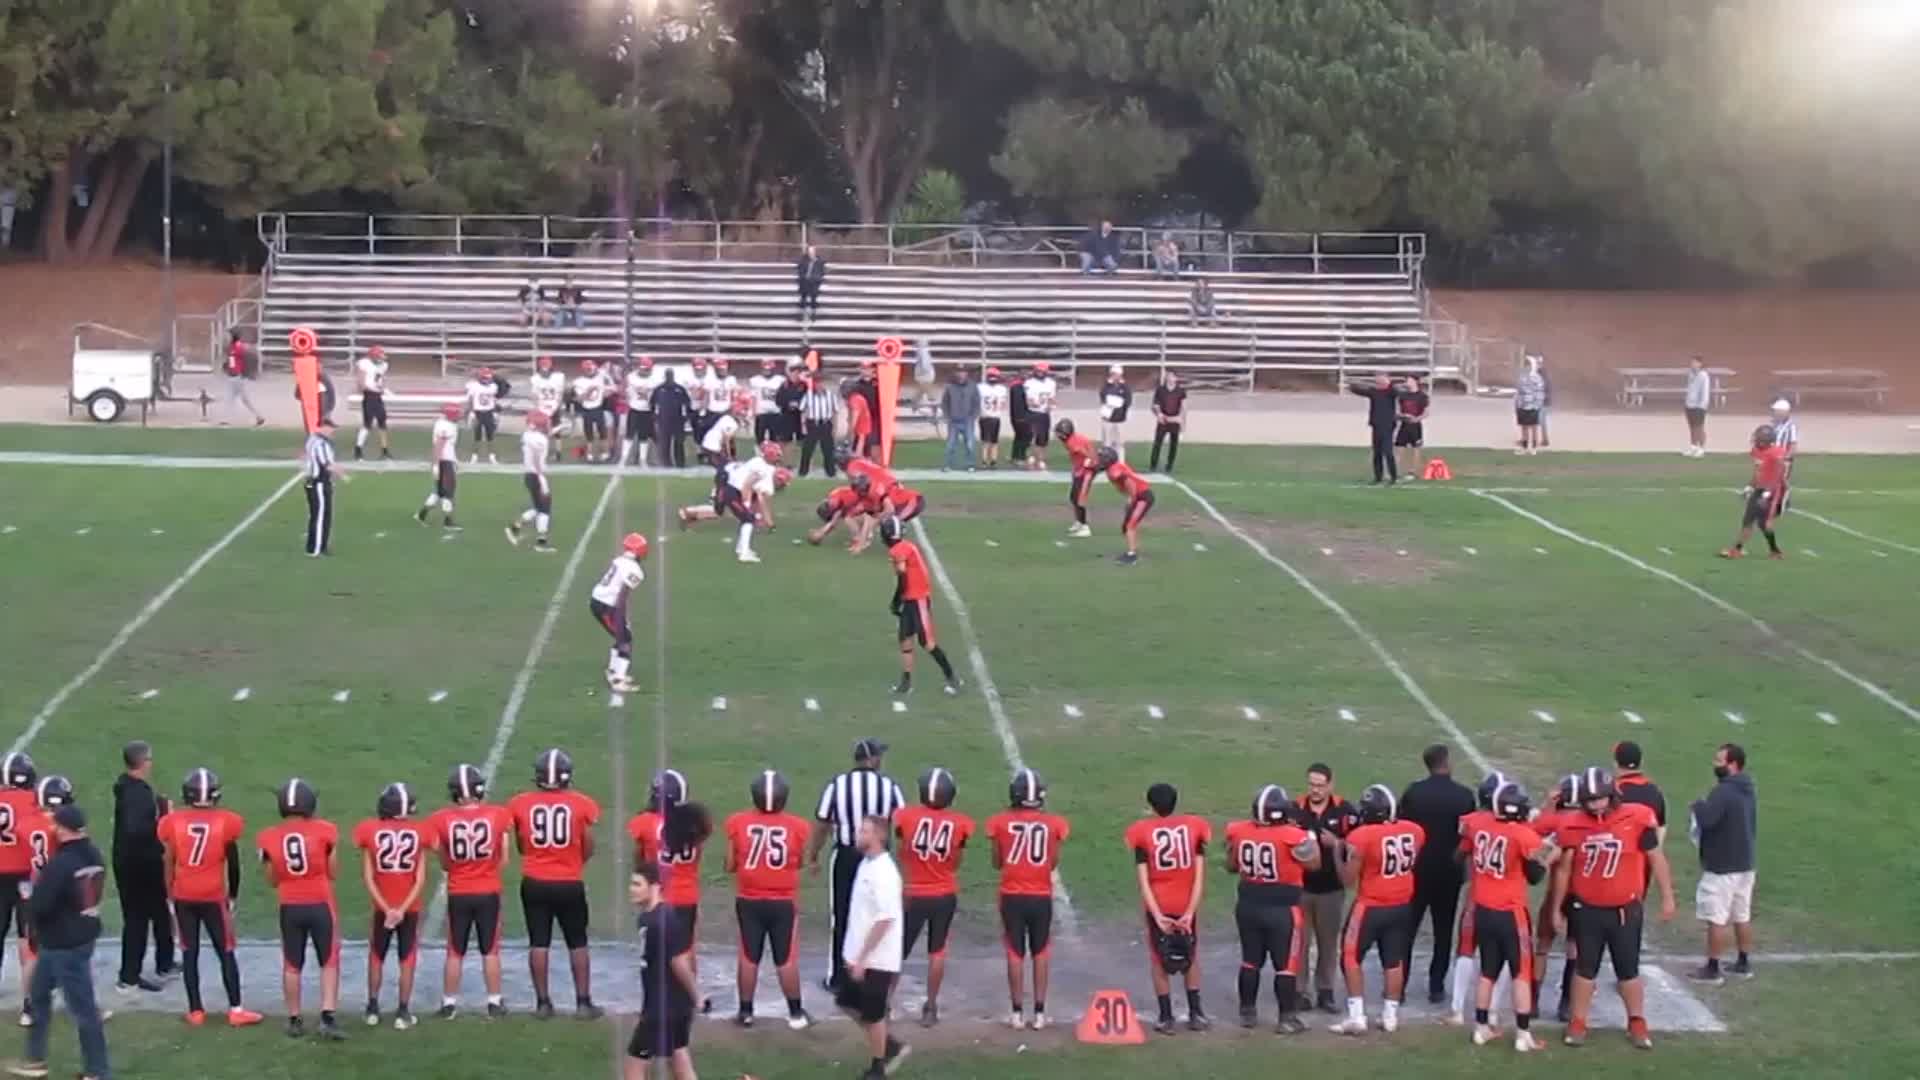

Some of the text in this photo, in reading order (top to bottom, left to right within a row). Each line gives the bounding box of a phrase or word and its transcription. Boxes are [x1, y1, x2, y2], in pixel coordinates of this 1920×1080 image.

[186, 823, 210, 867] 7
[449, 818, 492, 862] 62
[530, 803, 571, 848] 90
[744, 823, 788, 870] 75
[912, 817, 954, 862] 44
[1007, 821, 1049, 866] 70
[1152, 824, 1191, 870] 21
[282, 832, 309, 875] 9
[375, 829, 418, 872] 22
[1238, 840, 1279, 882] 99
[1382, 833, 1416, 879] 65
[1474, 830, 1507, 879] 34
[1581, 839, 1622, 879] 77
[1095, 997, 1127, 1035] 30
